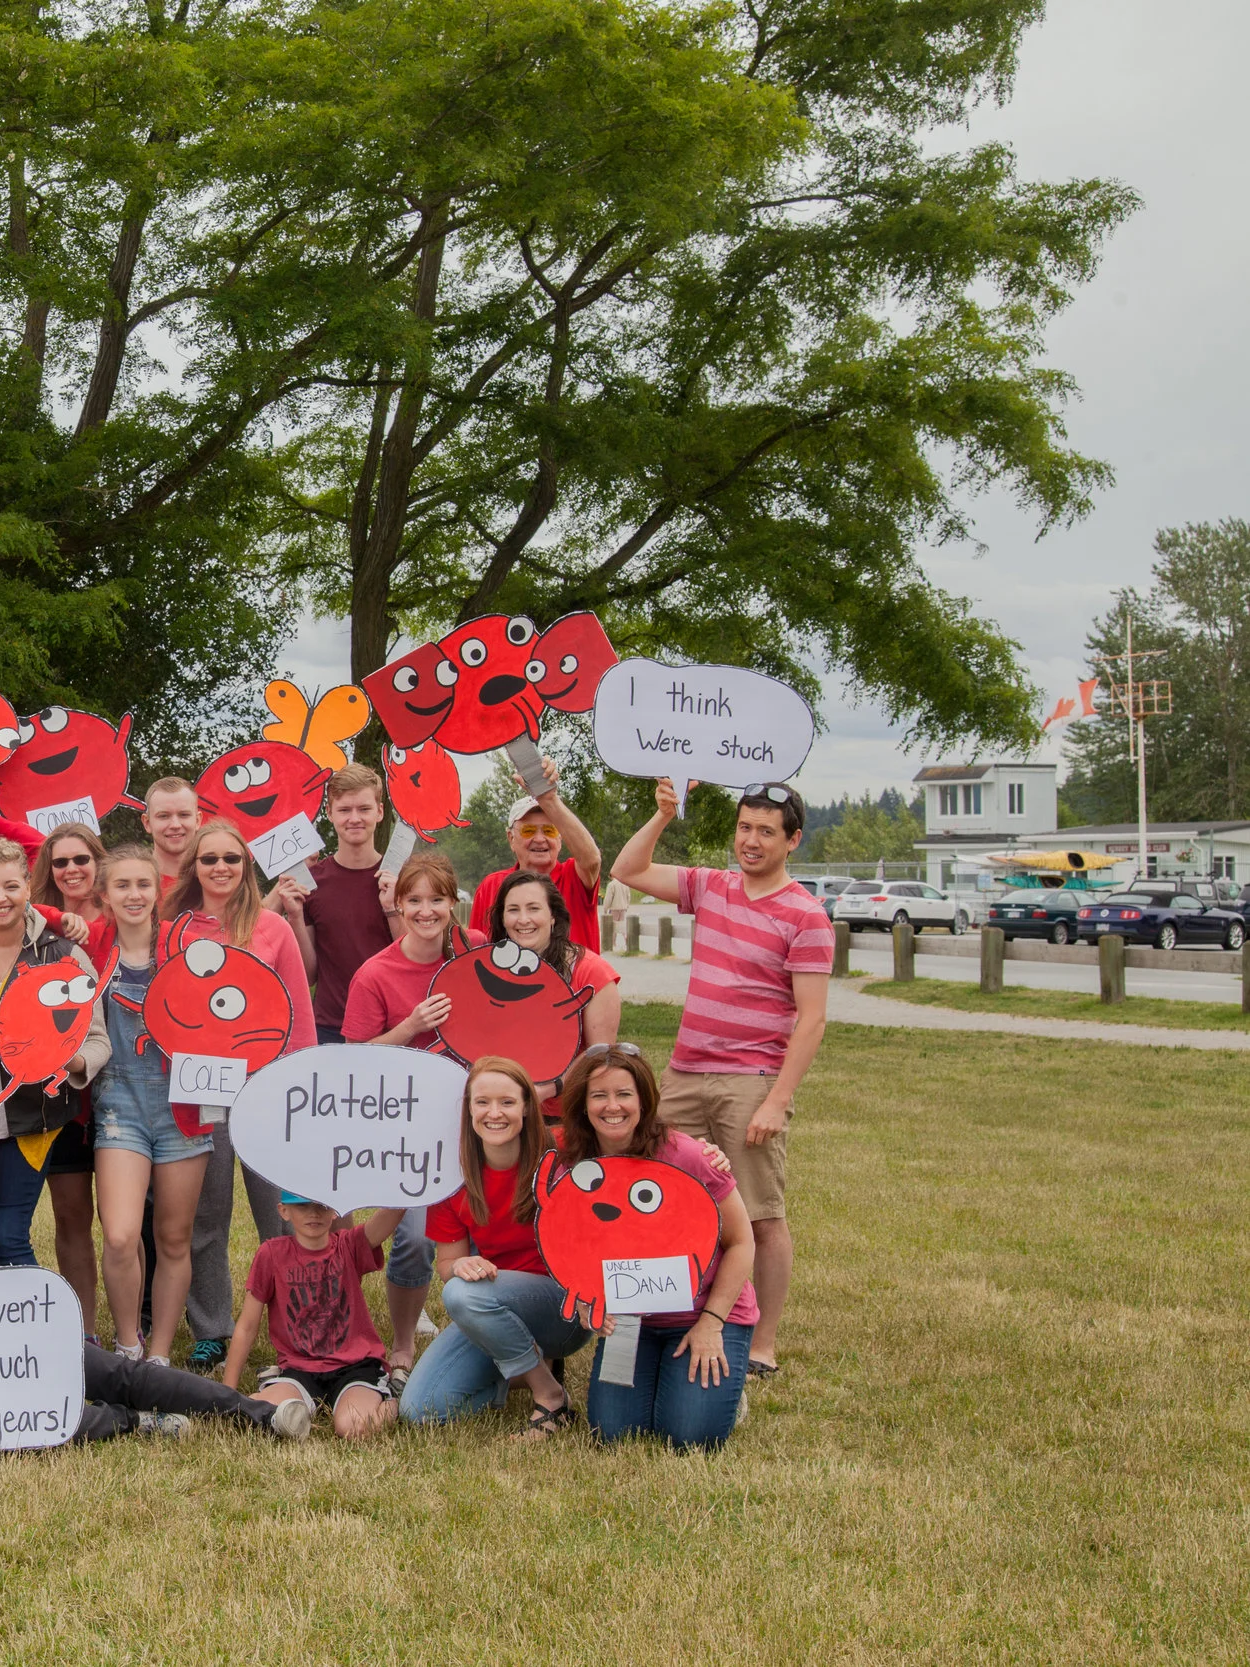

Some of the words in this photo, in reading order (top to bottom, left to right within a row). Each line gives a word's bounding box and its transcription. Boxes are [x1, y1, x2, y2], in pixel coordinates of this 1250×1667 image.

[630, 676, 635, 706] I
[666, 681, 732, 717] think
[636, 728, 693, 755] We're
[716, 735, 774, 764] stuck
[254, 825, 310, 870] ZOË
[179, 1057, 236, 1093] COLE
[285, 1072, 419, 1142] platelet
[332, 1136, 443, 1197] party!
[606, 1260, 642, 1272] UNCLE
[608, 1273, 677, 1300] DANA
